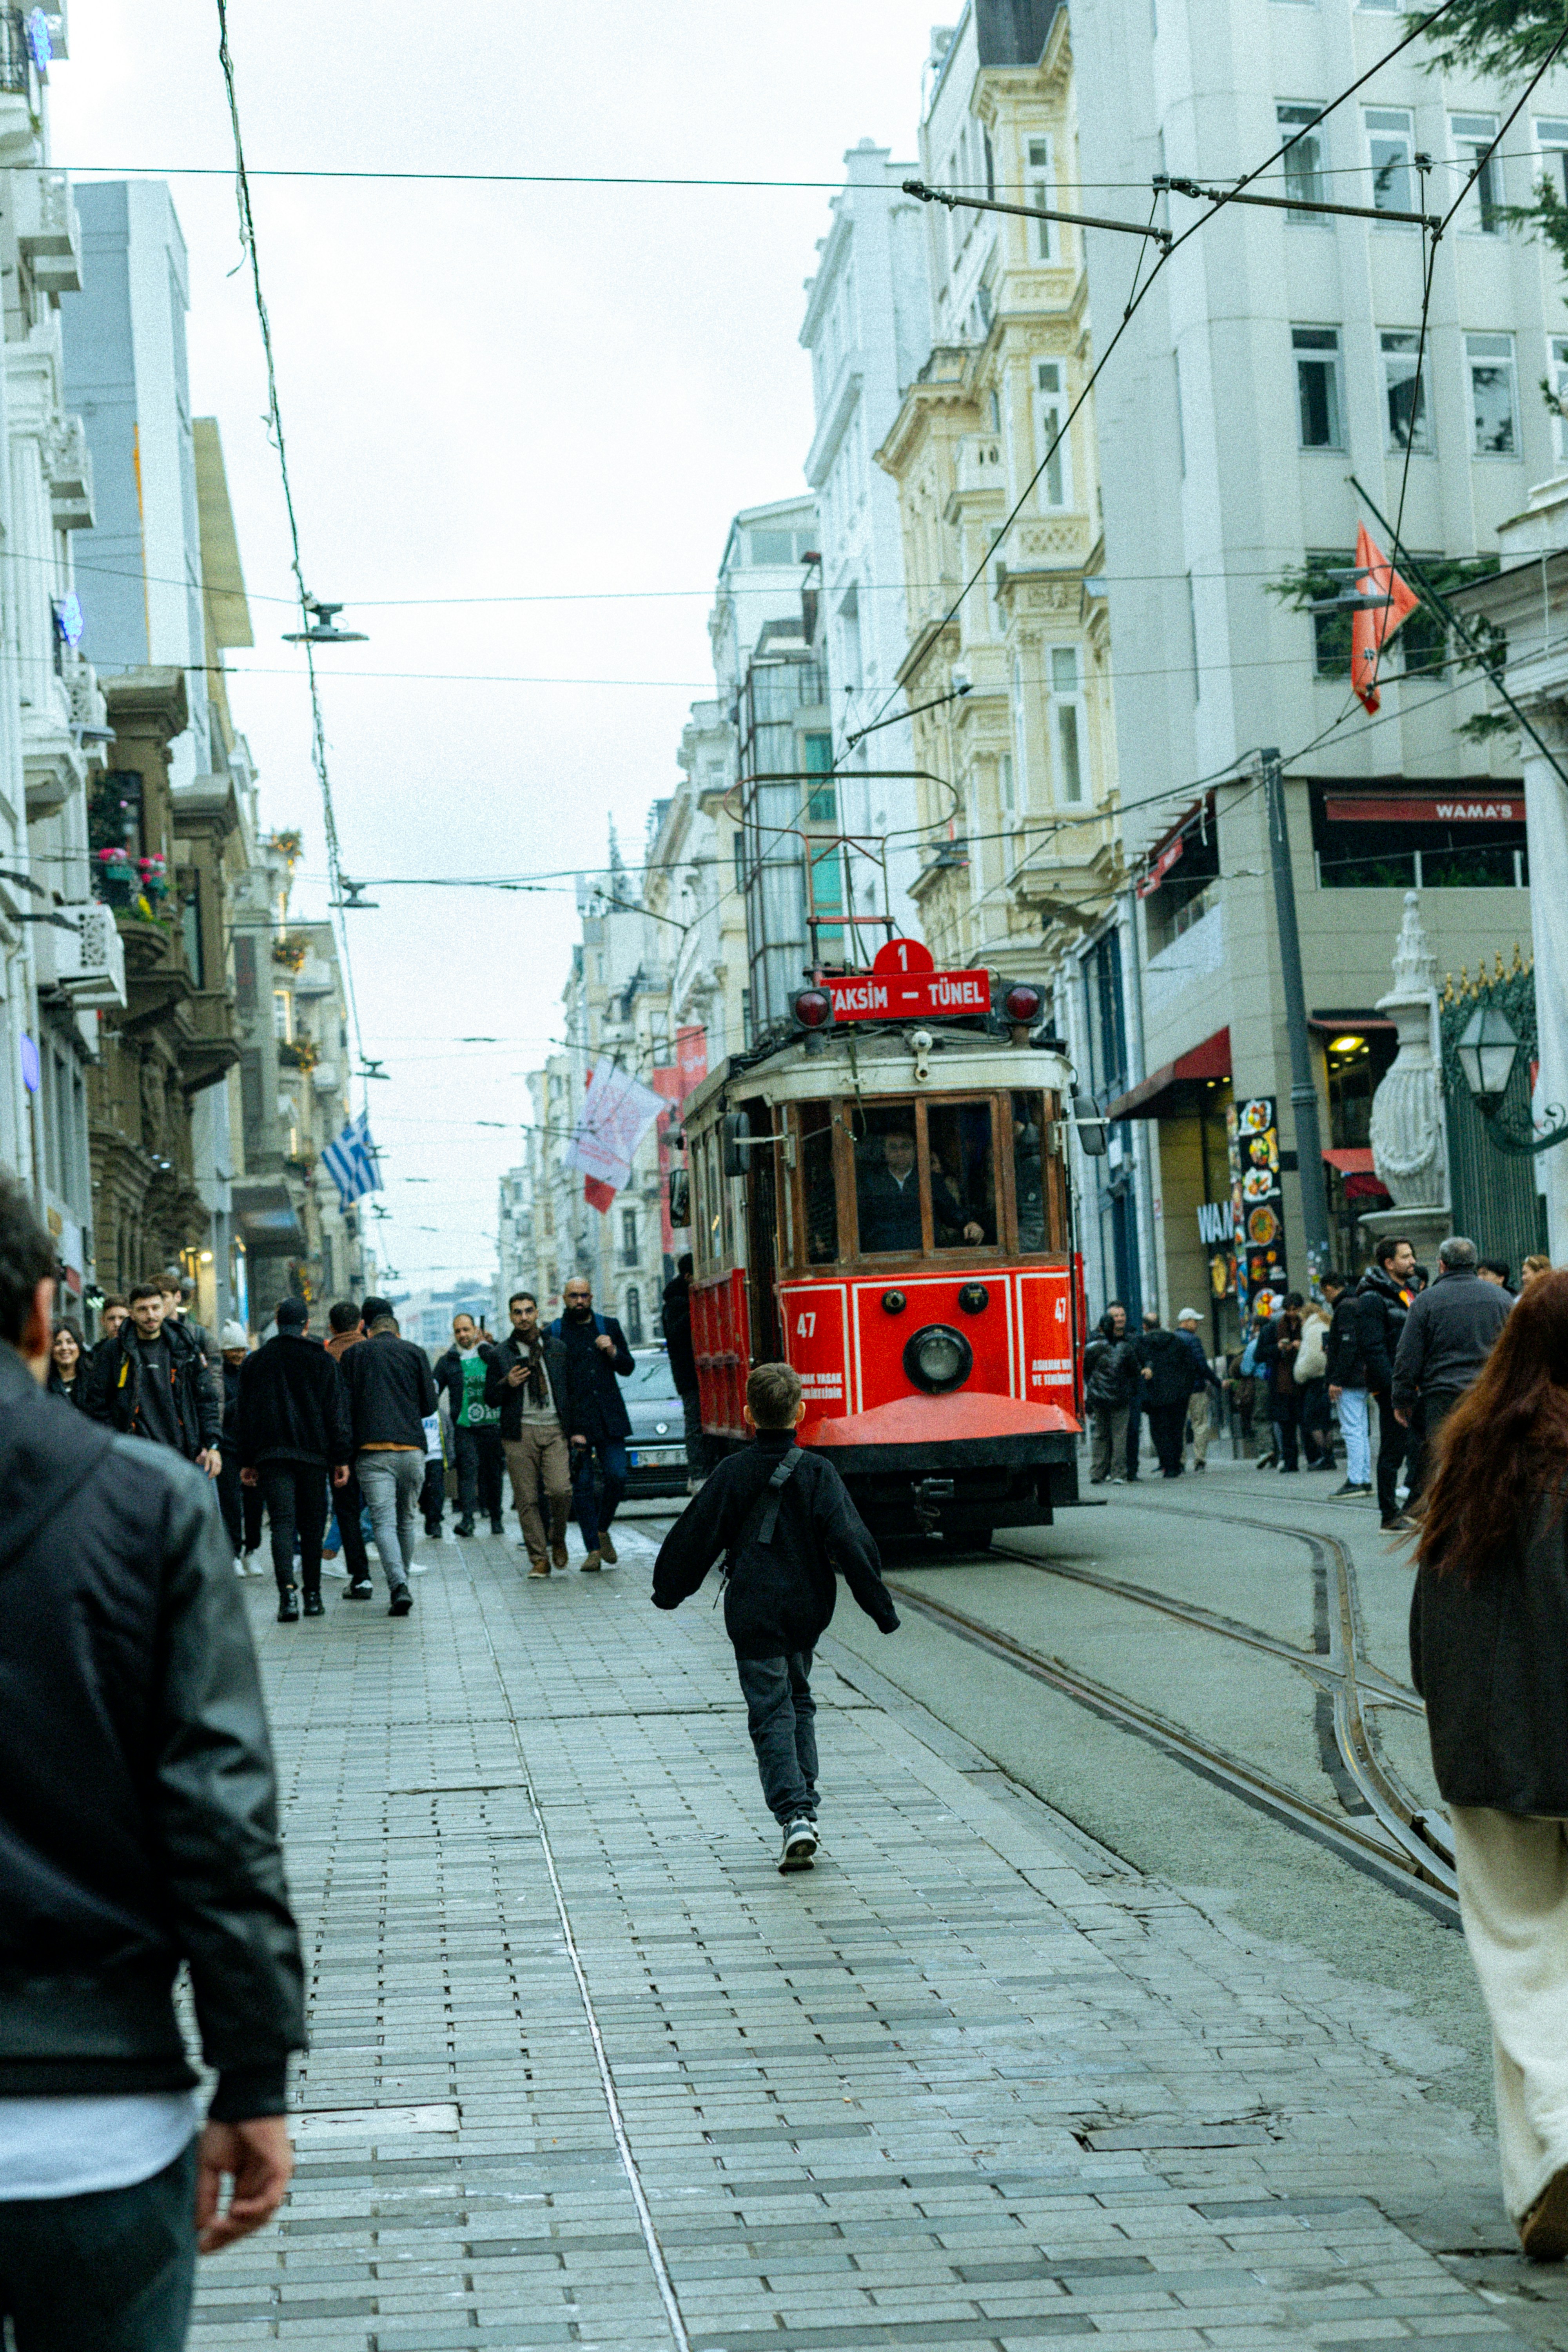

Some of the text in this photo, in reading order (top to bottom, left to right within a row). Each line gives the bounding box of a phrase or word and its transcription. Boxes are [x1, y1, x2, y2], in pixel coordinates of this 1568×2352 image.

[1436, 804, 1513, 818] WAMA'S
[897, 944, 908, 972] 1
[928, 977, 984, 1006] TÜNEL
[1055, 1296, 1066, 1323] 47
[797, 1312, 816, 1339] 47
